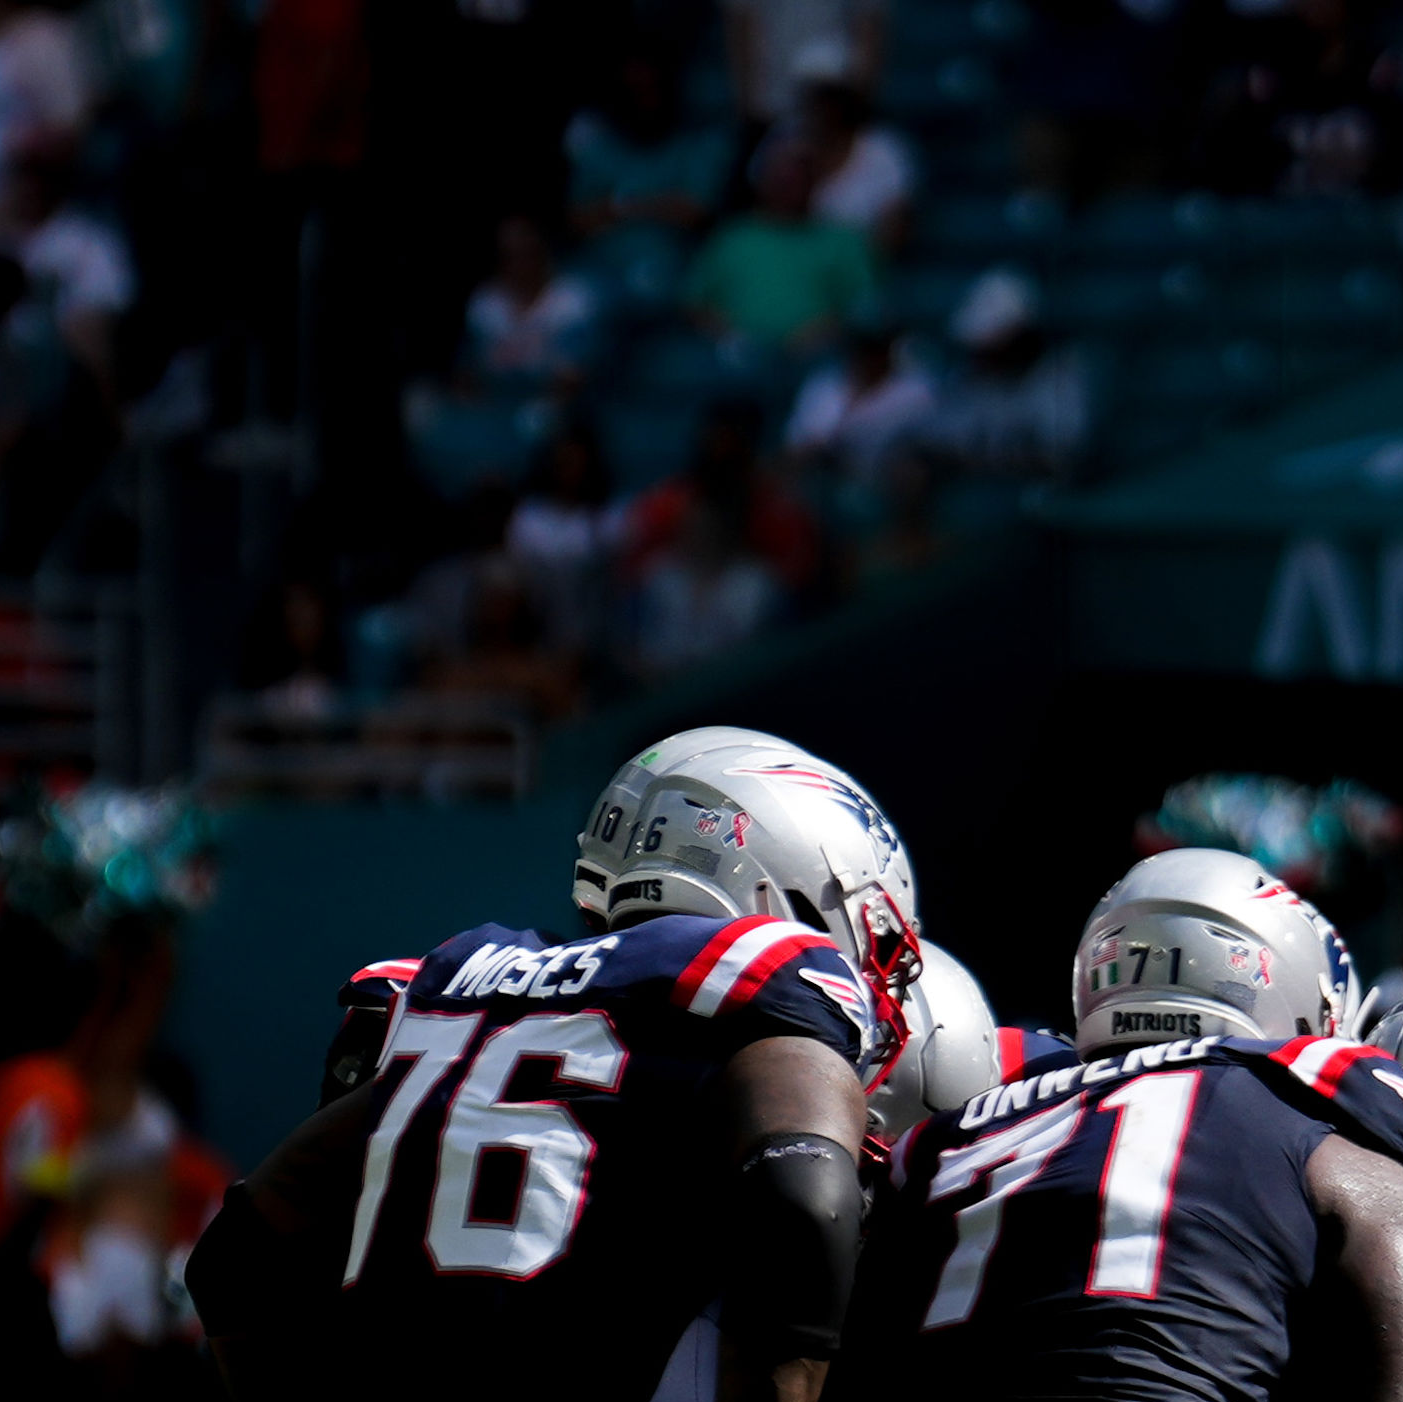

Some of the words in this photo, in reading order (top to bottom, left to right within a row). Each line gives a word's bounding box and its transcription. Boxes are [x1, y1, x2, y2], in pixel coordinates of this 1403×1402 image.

[592, 801, 623, 843] 10
[441, 935, 620, 1000] MOSES
[1127, 947, 1182, 985] 71
[1111, 1010, 1202, 1037] PATRIOTS
[342, 1008, 630, 1291] 76
[920, 1069, 1202, 1333] 71
